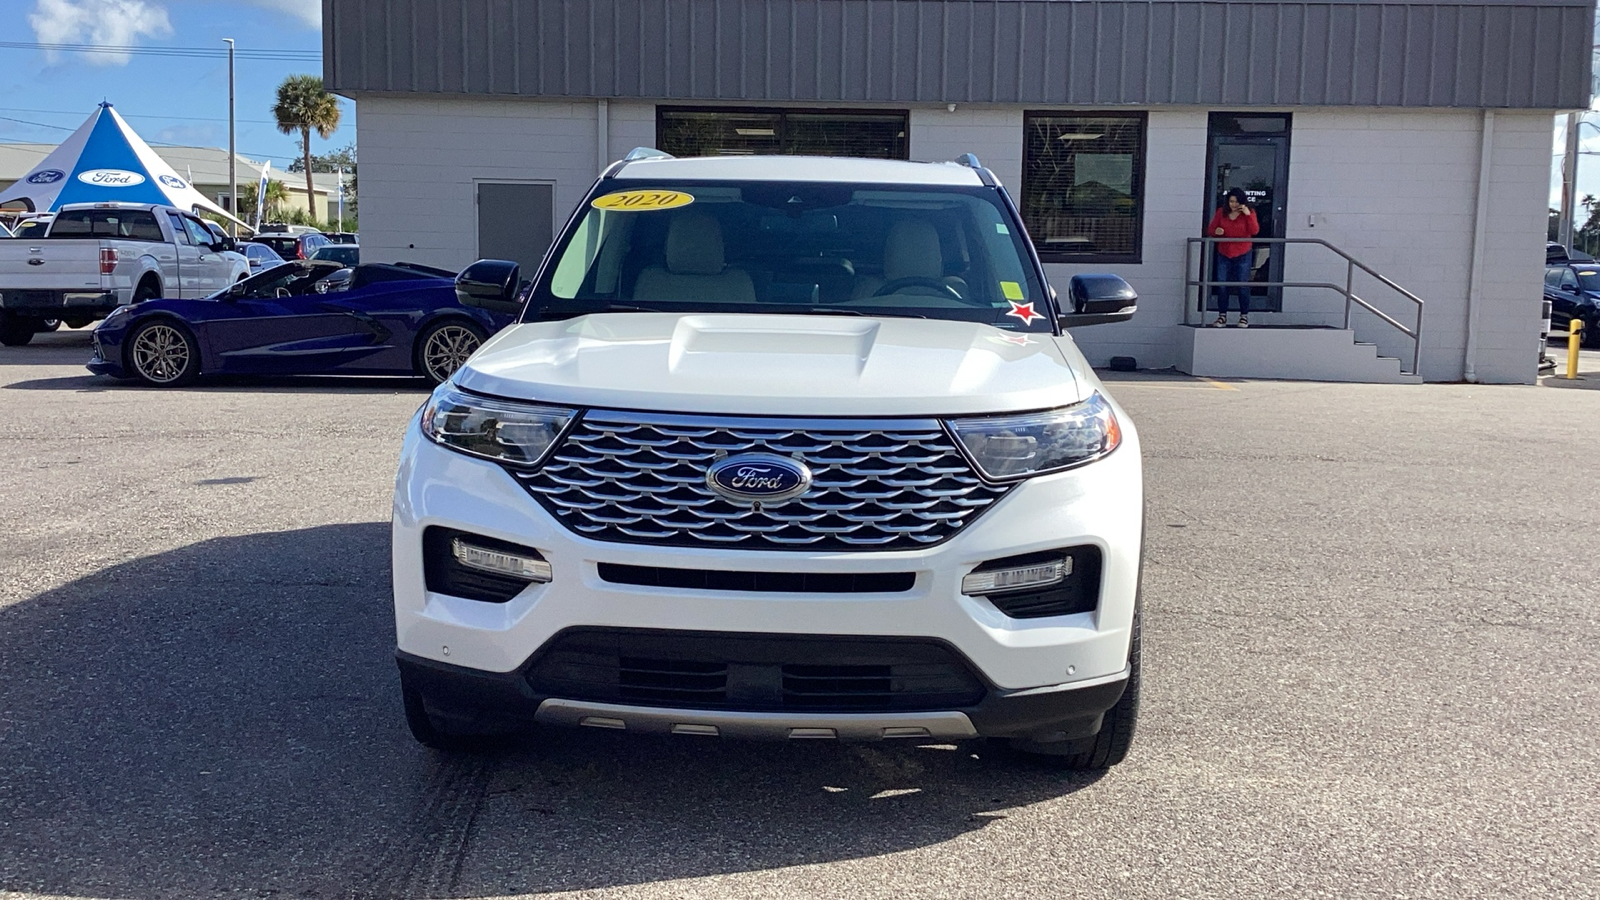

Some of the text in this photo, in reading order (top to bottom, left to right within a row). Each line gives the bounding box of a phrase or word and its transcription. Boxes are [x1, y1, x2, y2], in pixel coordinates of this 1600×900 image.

[31, 171, 59, 183] Ford
[92, 172, 131, 184] Ford
[606, 193, 679, 207] 2020
[731, 466, 784, 489] Ford
